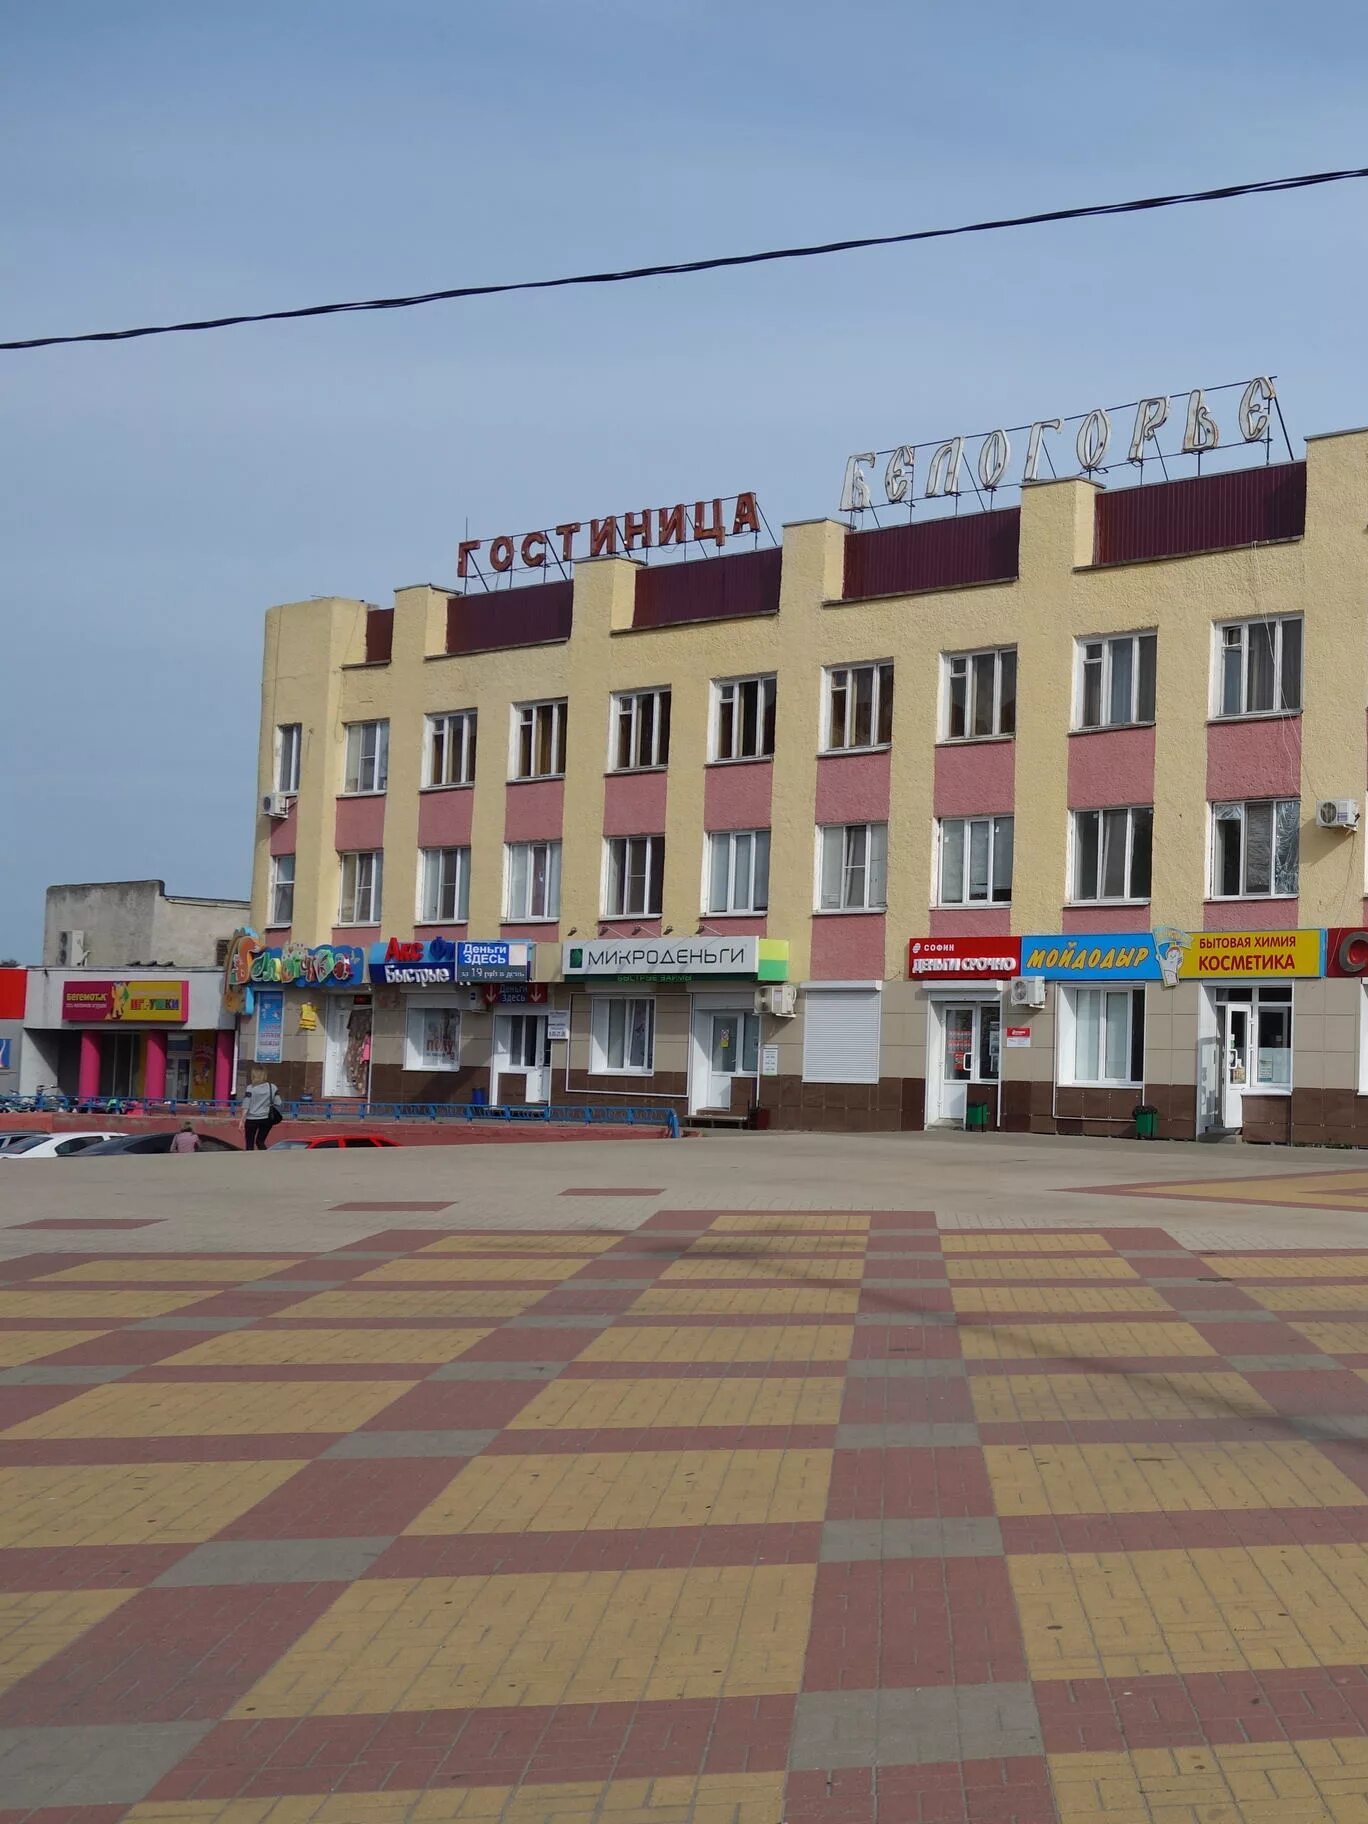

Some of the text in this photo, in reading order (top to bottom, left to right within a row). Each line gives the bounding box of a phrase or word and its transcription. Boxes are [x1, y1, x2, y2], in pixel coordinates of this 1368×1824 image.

[839, 376, 1276, 511] БЕЛОГОРЬЕ
[457, 492, 760, 577] ГОСТИНИЦА
[463, 944, 506, 955] Деньги
[924, 944, 955, 952] СОФИН
[1199, 936, 1296, 949] БЫТОВАЯ ХИМИЯ
[464, 954, 505, 965] ЗДЕСЬ
[588, 948, 744, 965] МИКРОДЕНЬГИ
[1026, 942, 1149, 970] МОЙДОДЫР
[1199, 954, 1296, 971] КОСМЕТИКА
[912, 957, 1017, 973] ДЕНЬГИ СРОЧНО
[384, 964, 449, 987] Быстрые
